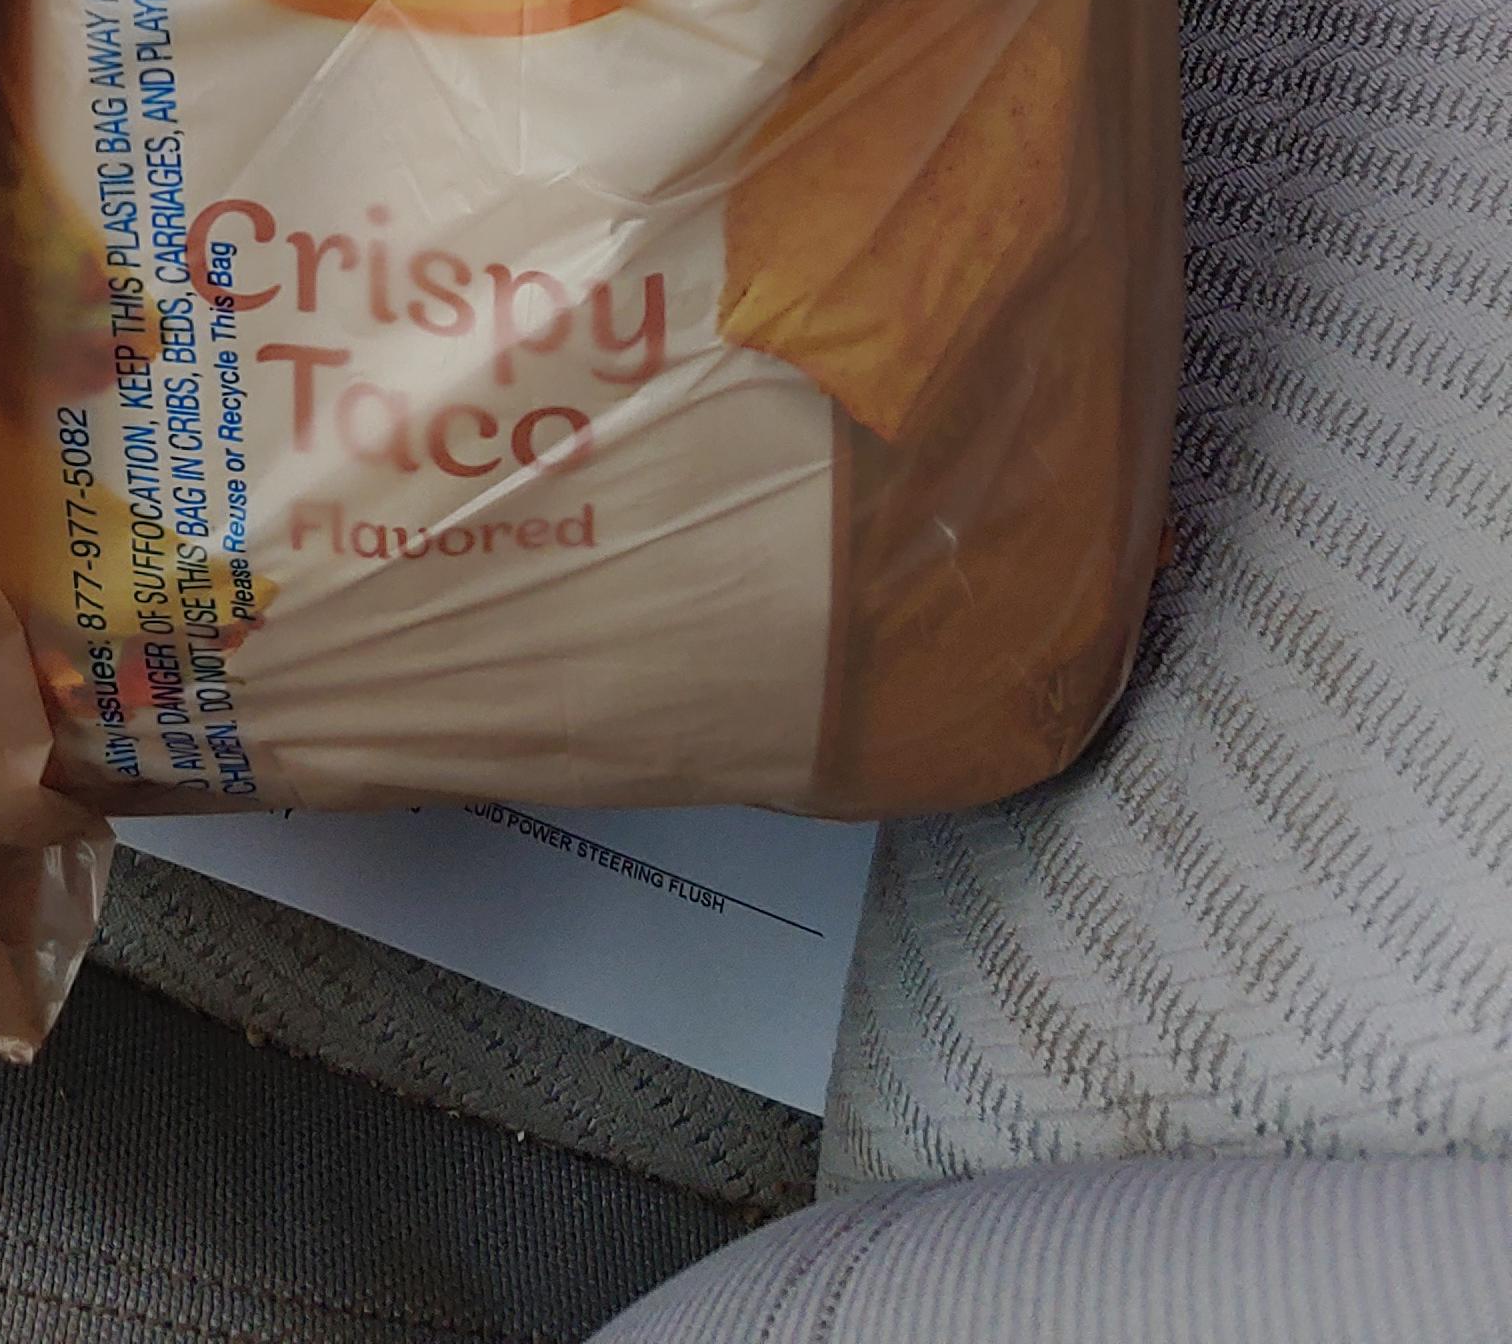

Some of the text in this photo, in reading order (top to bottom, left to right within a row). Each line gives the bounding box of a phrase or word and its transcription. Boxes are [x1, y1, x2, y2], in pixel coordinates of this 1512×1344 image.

[84, 9, 126, 89] AWAY
[91, 96, 132, 154] BAG
[139, 67, 179, 125] AND
[97, 162, 142, 268] PLASTIC
[144, 129, 192, 285] CARRIAGES,
[107, 276, 146, 338] THIS
[185, 197, 668, 385] Crispy
[156, 291, 198, 364] BEDS,
[114, 344, 154, 410] KEEP
[163, 372, 205, 451] CRIBS,
[254, 341, 595, 480] Taco
[207, 241, 258, 622] Please Reuse or Recycle This Bag
[170, 455, 206, 482] IN
[121, 420, 169, 604] SUFFOCATION,
[172, 486, 210, 538] BAG
[291, 502, 601, 562] Flavored
[57, 407, 140, 778] ality issues: 877-977-5082
[176, 542, 215, 595] THIS
[137, 609, 175, 636] OF
[181, 597, 221, 640] USE
[144, 641, 191, 726] DANGER
[188, 643, 228, 683] NOT
[196, 687, 234, 713] DO
[506, 814, 573, 854] POWER
[577, 841, 665, 890] STEERING
[668, 878, 727, 914] FLUSH
